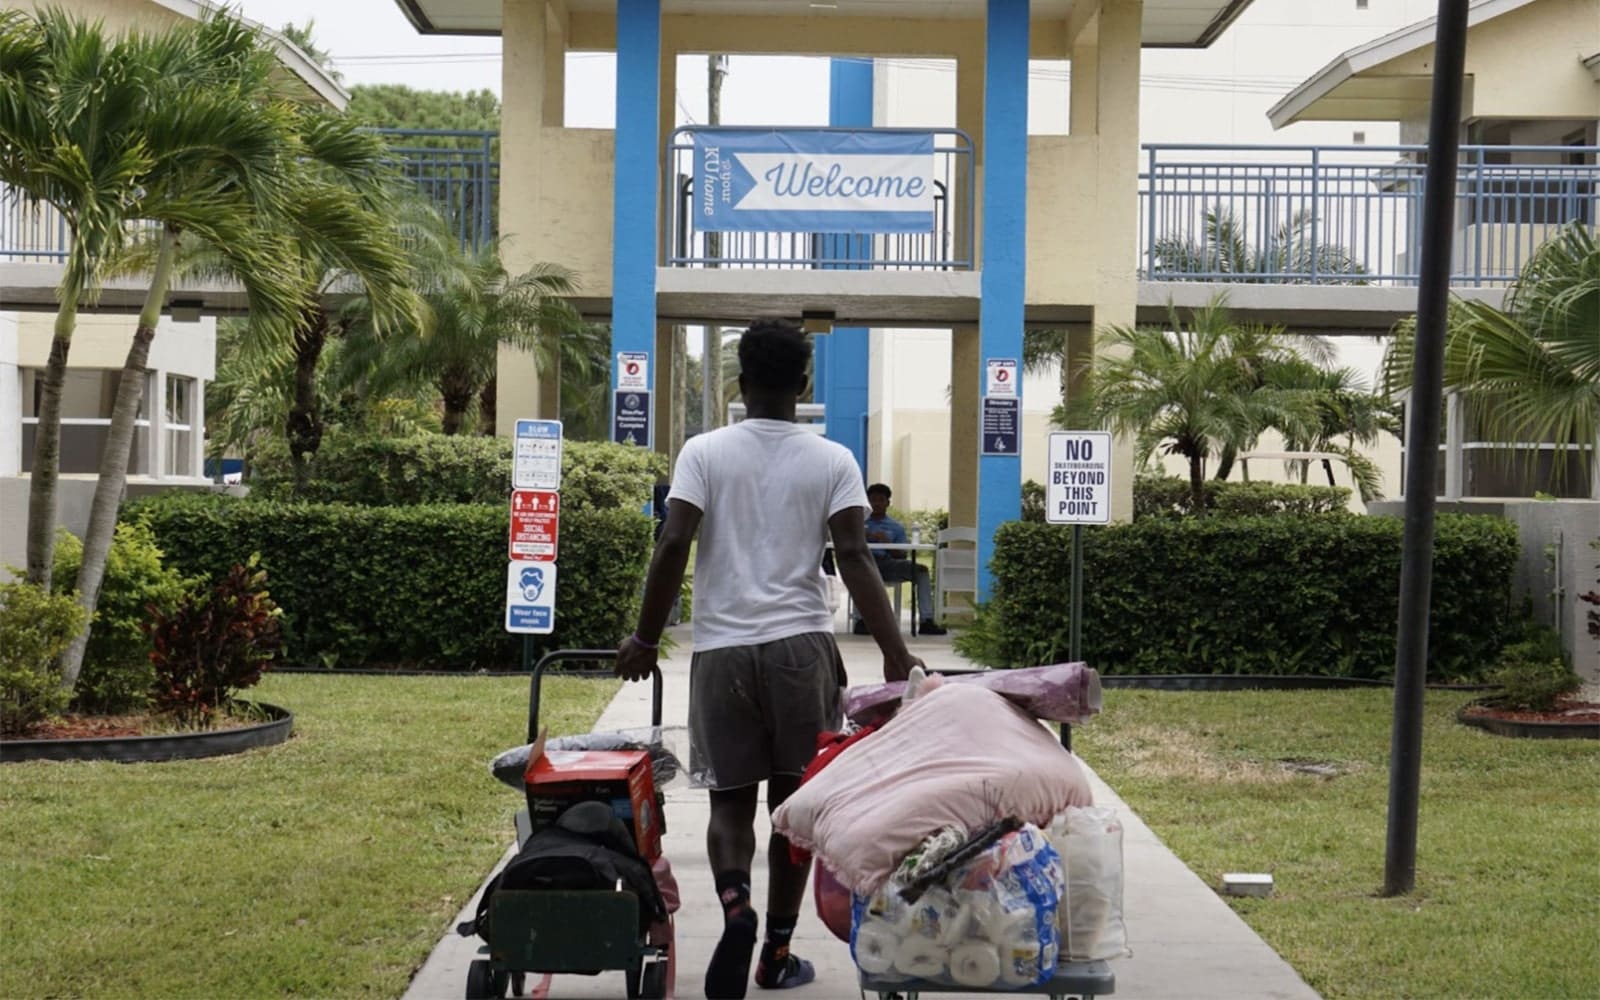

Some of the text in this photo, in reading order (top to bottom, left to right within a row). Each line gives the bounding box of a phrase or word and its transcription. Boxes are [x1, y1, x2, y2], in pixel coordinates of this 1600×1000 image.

[704, 147, 720, 216] KU home
[720, 171, 731, 203] your
[765, 162, 926, 198] Welcome
[1066, 440, 1093, 461] NO
[1053, 471, 1105, 485] BEYOND
[1064, 486, 1093, 500] THIS
[1059, 501, 1098, 516] POINT
